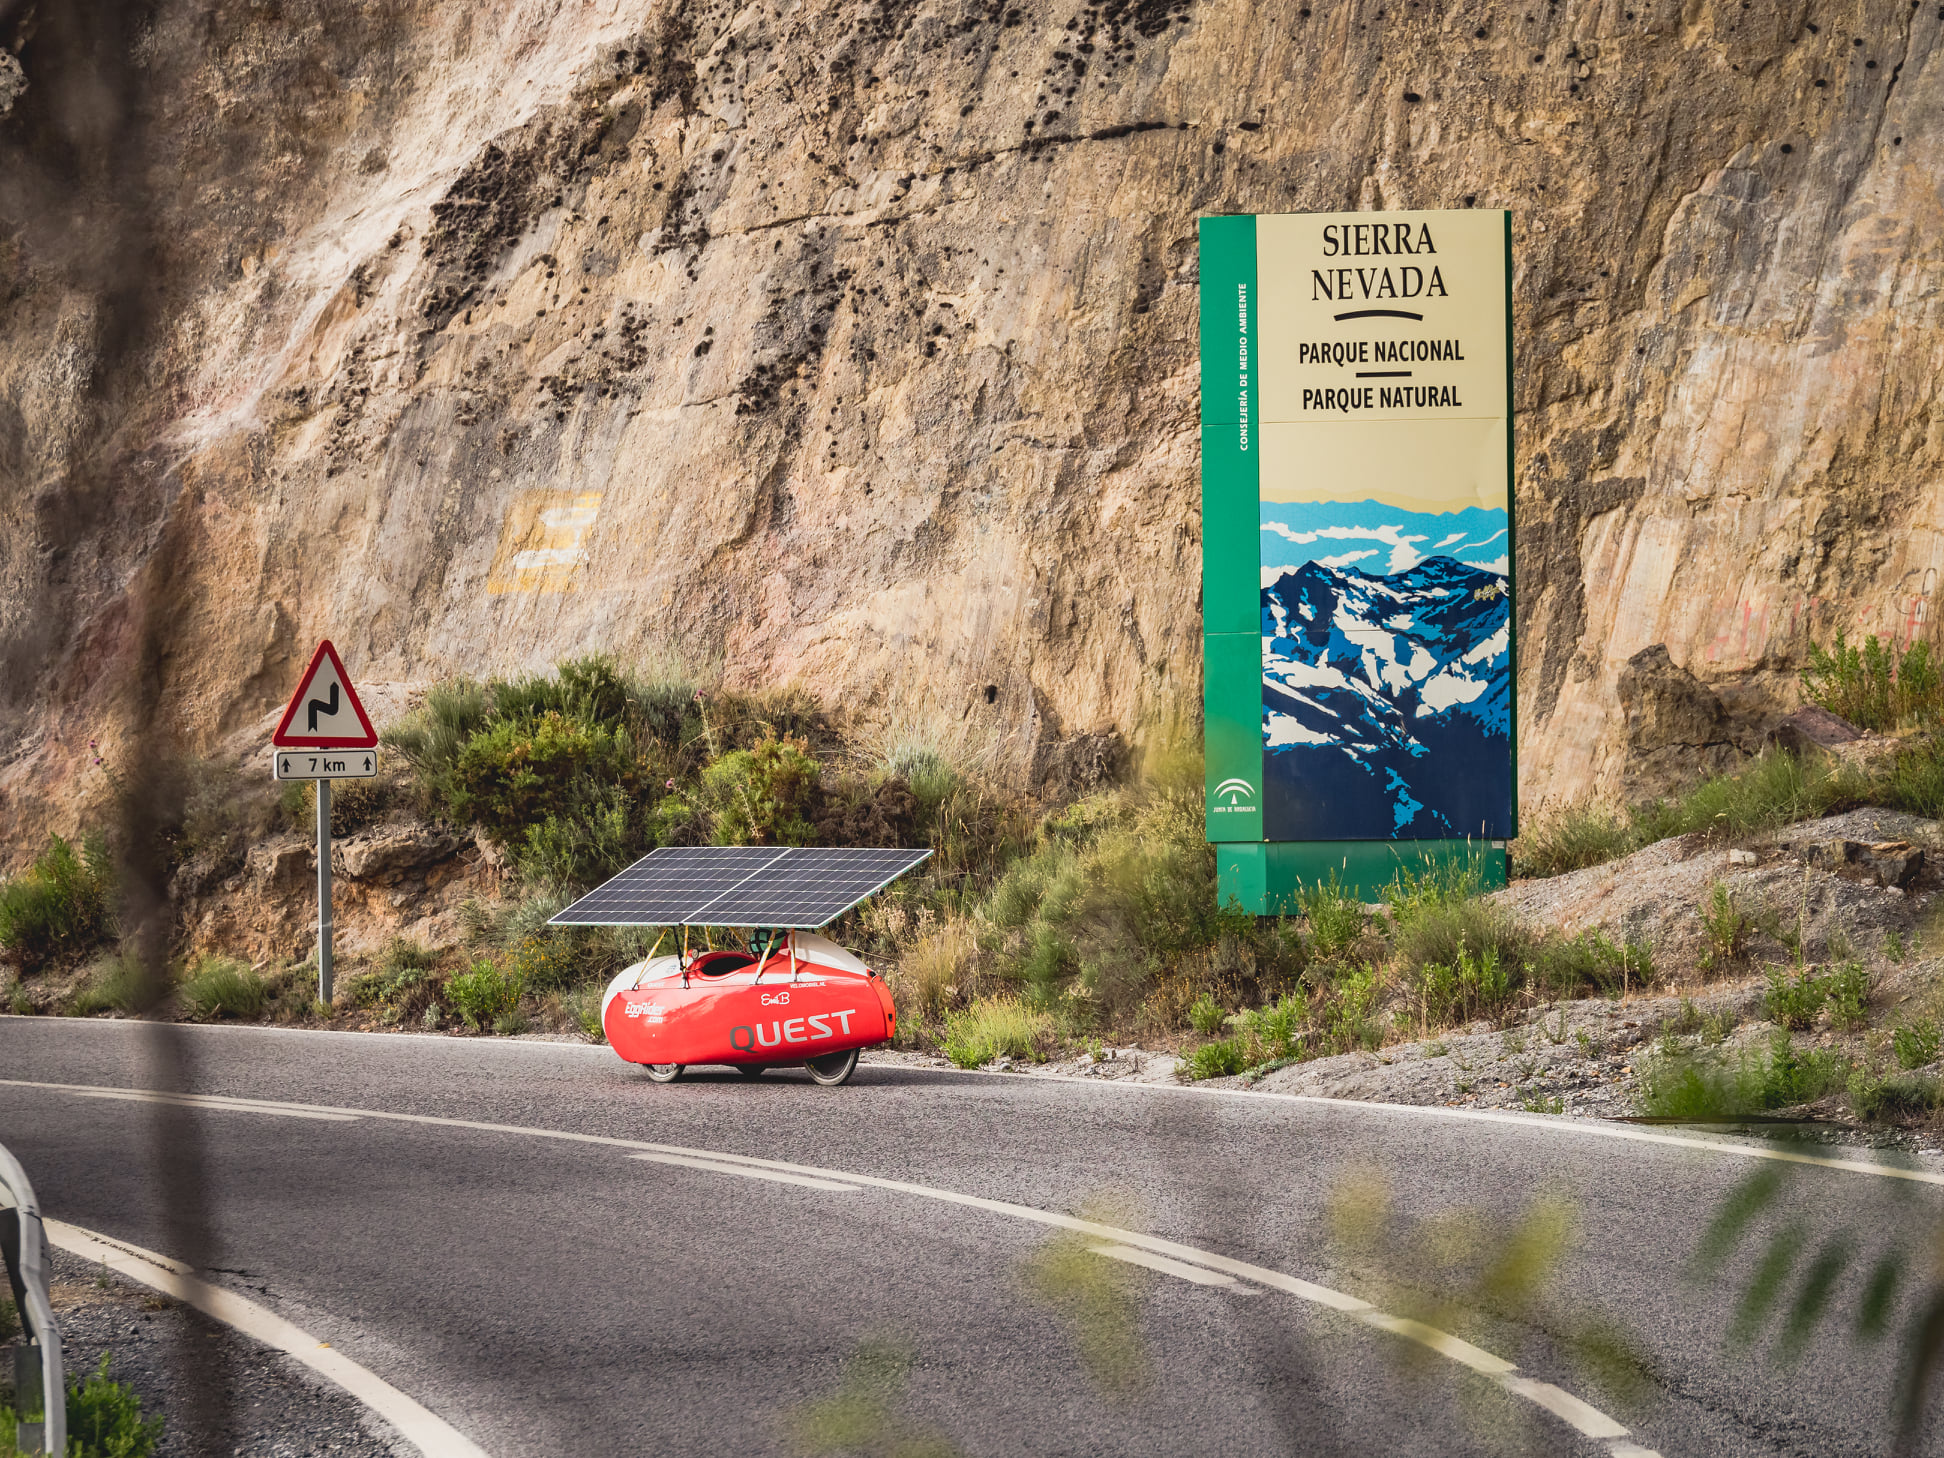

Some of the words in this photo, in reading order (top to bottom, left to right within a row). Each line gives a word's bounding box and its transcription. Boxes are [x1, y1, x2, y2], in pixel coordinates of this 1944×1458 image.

[1322, 222, 1437, 257] SIERRA
[1311, 265, 1449, 301] NEVADA
[1238, 283, 1247, 334] AMBIENTE
[1239, 336, 1248, 370] MEDIO
[1299, 341, 1369, 367] PARQUE
[1374, 339, 1465, 362] NACIONAL
[1239, 373, 1248, 387] DE
[1302, 387, 1374, 413] PARQUE
[1379, 385, 1462, 409] NATURAL
[1237, 389, 1249, 451] CONSEJERÍA
[308, 758, 318, 772] 7
[323, 758, 346, 772] km
[624, 1001, 665, 1018] EggRider
[729, 1008, 856, 1054] QUEST
